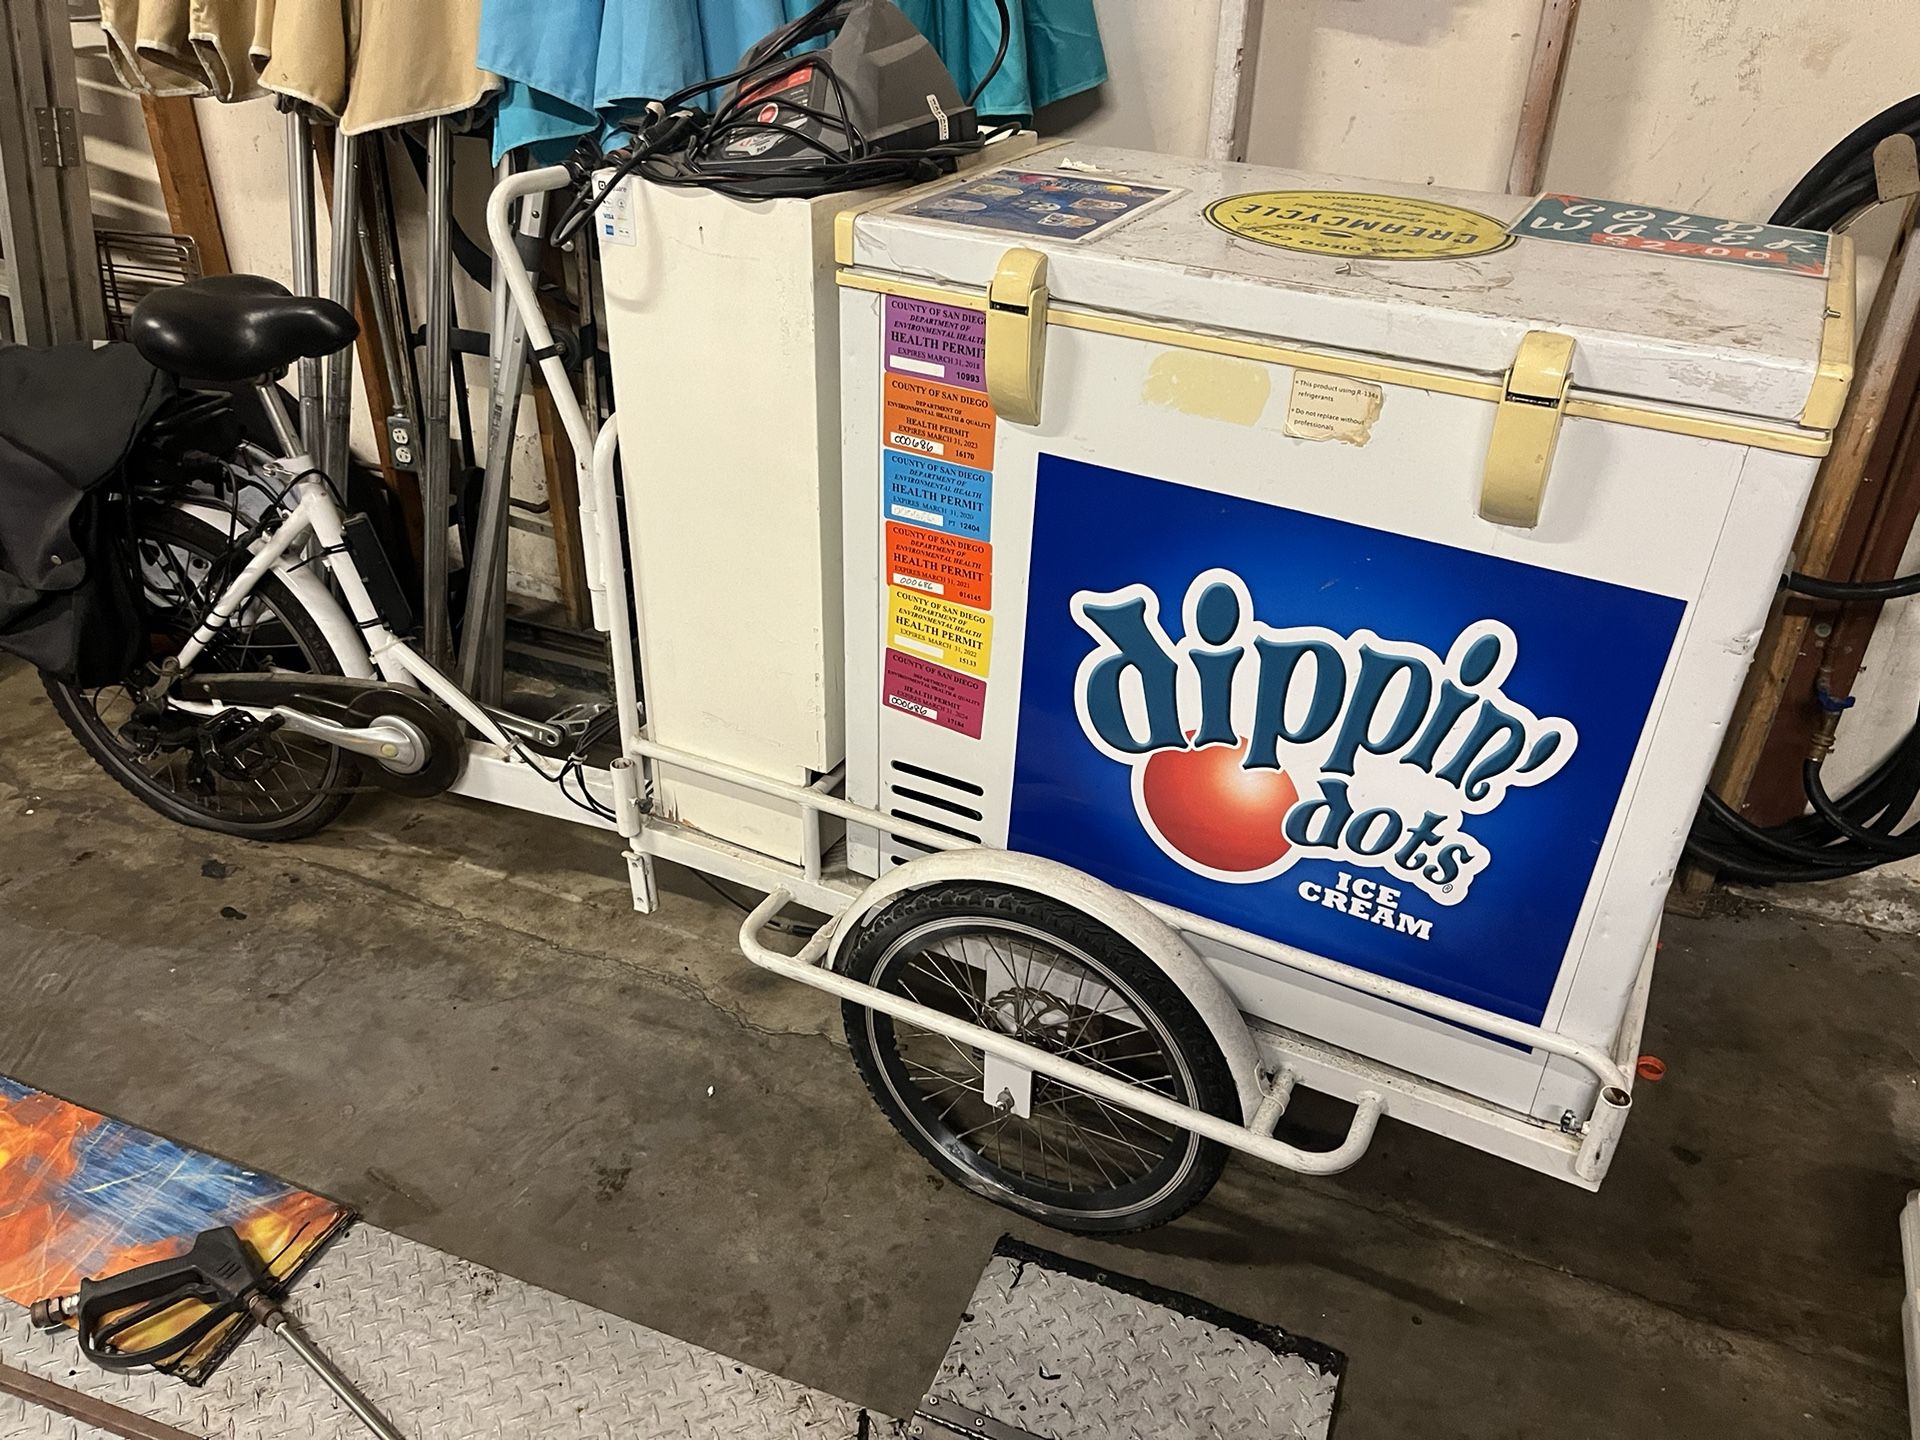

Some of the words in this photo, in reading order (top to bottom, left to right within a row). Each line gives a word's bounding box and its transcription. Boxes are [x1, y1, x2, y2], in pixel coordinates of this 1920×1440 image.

[1236, 204, 1479, 244] CREAMCYCLE
[1562, 203, 1764, 234] COLD
[1530, 216, 1818, 253] WATER
[1299, 240, 1361, 251] DIEGO
[891, 300, 927, 314] COUNTY
[929, 307, 941, 316] OF
[943, 310, 960, 320] SAN
[894, 320, 955, 339] ENVIRONMENTAL
[910, 314, 959, 330] DEPARTMENT
[891, 331, 939, 350] HEALTH
[897, 347, 926, 359] EXPIRES
[927, 353, 954, 364] MARCH
[956, 371, 981, 383] 10993
[891, 380, 927, 395] COUNTY
[928, 388, 941, 397] OF
[941, 391, 959, 401] SAN
[960, 396, 989, 409] DIEGO
[1298, 391, 1334, 402] refrigerants
[1300, 380, 1312, 388] This
[1313, 382, 1338, 392] product
[1339, 387, 1356, 396] using
[1357, 389, 1379, 399] R-134a
[887, 401, 935, 417] ENVIRONMENTAL
[936, 412, 960, 422] HEALTH
[966, 419, 991, 430] QUALITY
[915, 400, 954, 414] DEPARTMENT
[906, 417, 938, 431] HEALTH
[939, 425, 970, 438] PERMIT
[1317, 412, 1339, 422] replace
[1340, 416, 1365, 426] without
[898, 425, 926, 437] EXPIRES
[927, 432, 953, 443] MARCH
[891, 455, 926, 469] COUNTY
[927, 463, 939, 472] OF
[940, 465, 956, 475] SAN
[958, 470, 985, 483] DIEGO
[909, 468, 955, 484] DEPARTMENT
[956, 479, 967, 487] OF
[894, 473, 952, 492] ENVIRONMENTAL
[953, 486, 983, 499] HEALTH
[892, 483, 937, 501] HEALTH
[940, 493, 984, 512] PERMIT
[893, 496, 920, 508] EXPIRES
[922, 501, 948, 514] MARCH
[960, 521, 980, 532] 12404
[893, 526, 926, 540] COUNTY
[927, 534, 938, 543] OF
[940, 536, 956, 547] SAN
[957, 541, 985, 554] DIEGO
[911, 540, 955, 555] DEPARTMENT
[893, 552, 938, 571] HEALTH
[940, 563, 984, 582] PERMIT
[896, 544, 952, 562] ENVIRONMENTAL
[953, 558, 982, 569] HEALTH
[894, 565, 920, 576] EXPIRES
[921, 572, 946, 584] MARCH
[896, 591, 929, 606] COUNTY
[930, 601, 942, 610] OF
[943, 605, 958, 616] SAN
[959, 610, 986, 624] DIEGO
[913, 605, 957, 623] DEPARTMENT
[957, 619, 968, 627] OF
[895, 615, 939, 637] HEALTH
[941, 629, 984, 650] PERMIT
[898, 607, 953, 630] ENVIRONMENTAL
[954, 625, 982, 638] HEALTH
[900, 628, 926, 641] EXPIRES
[928, 637, 952, 650] MARCH
[892, 654, 924, 670] COUNTY
[925, 665, 935, 674] OF
[937, 670, 952, 680] SAN
[954, 675, 979, 689] DIEGO
[904, 685, 933, 700] HEALTH
[934, 695, 961, 710] PERMIT
[922, 699, 945, 712] MARCH
[958, 695, 980, 707] QUALITY
[1335, 871, 1402, 909] ICE
[1298, 881, 1433, 941] CREAM
